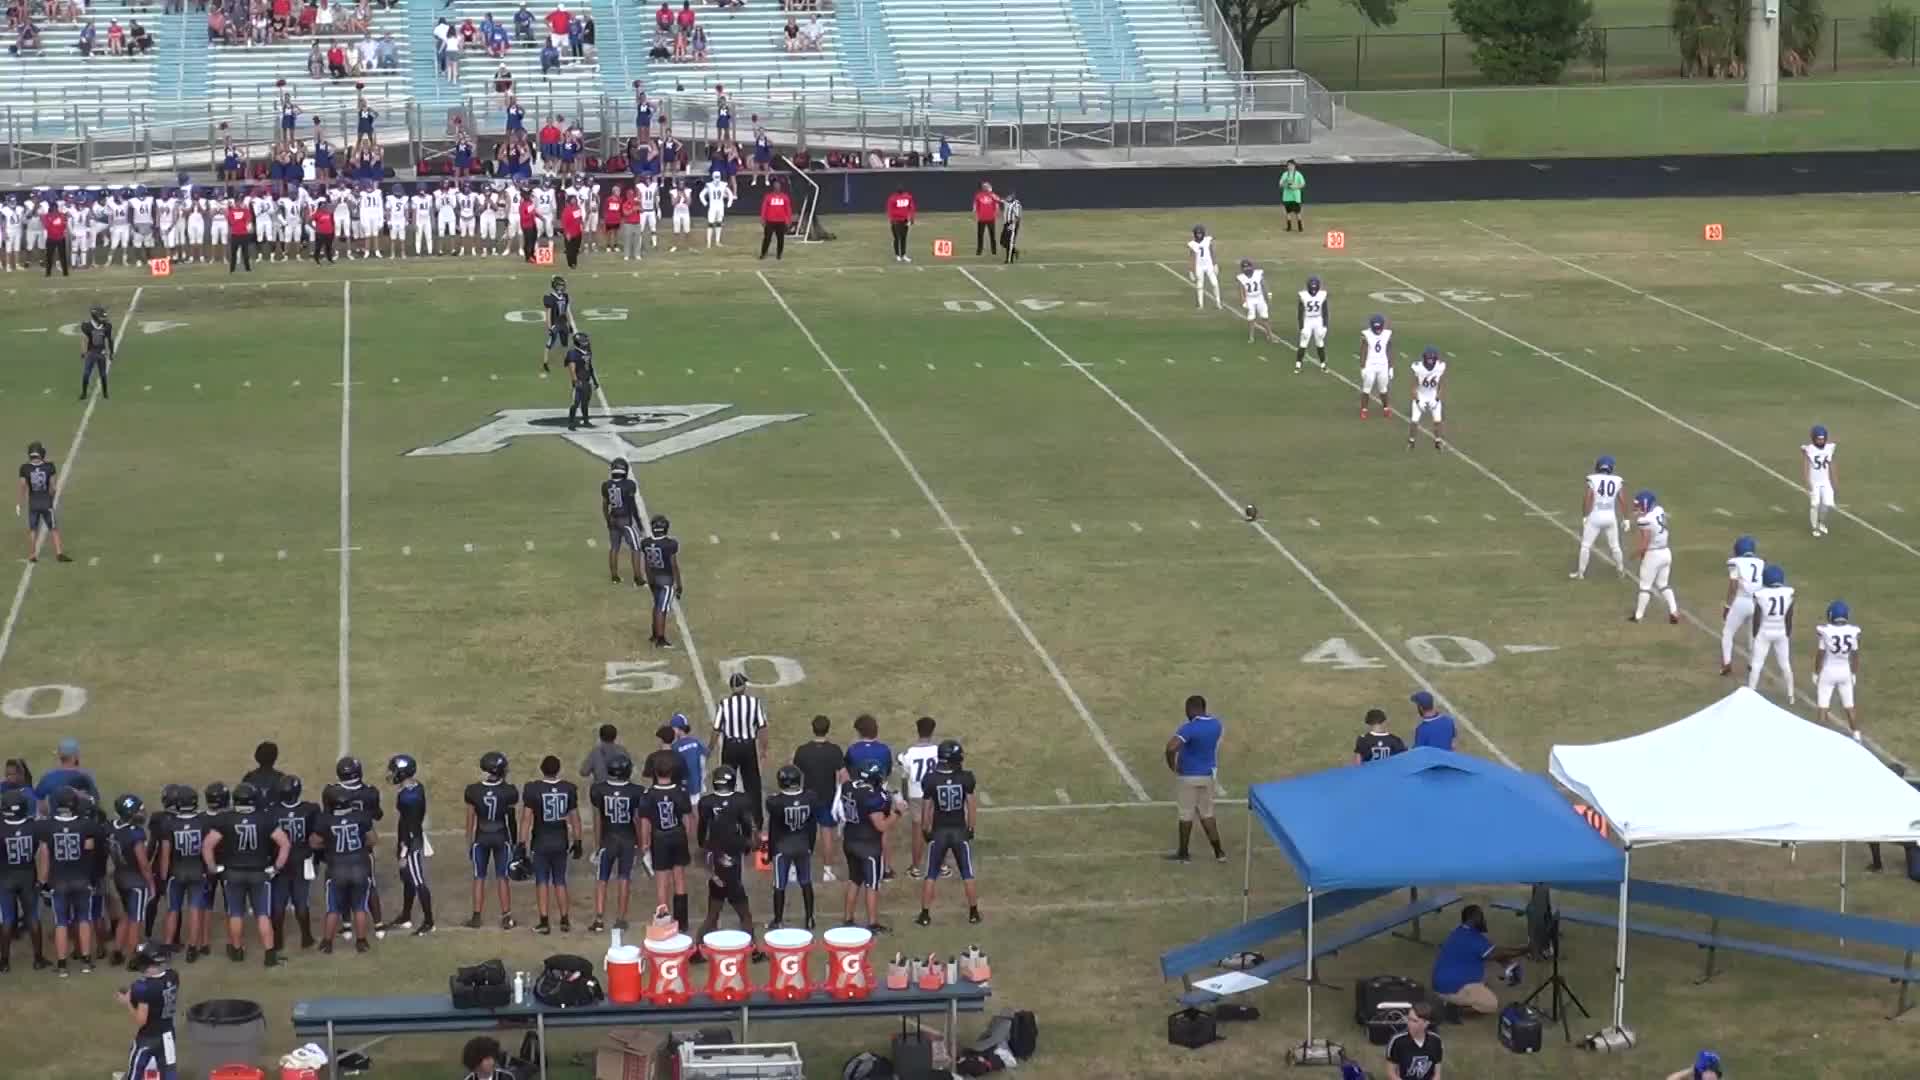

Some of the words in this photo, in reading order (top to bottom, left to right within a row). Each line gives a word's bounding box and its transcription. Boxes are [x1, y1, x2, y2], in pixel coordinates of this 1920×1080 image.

[1329, 233, 1343, 247] 30
[1708, 226, 1721, 239] 20
[153, 259, 168, 273] 40
[538, 249, 552, 263] 50
[1306, 300, 1321, 313] 55
[1374, 340, 1382, 354] 6
[1422, 375, 1437, 389] 66
[1597, 479, 1616, 498] 40
[1750, 563, 1758, 584] 2
[1767, 594, 1785, 616] 21
[1300, 635, 1496, 670] 40
[1830, 634, 1853, 655] 35
[600, 655, 806, 693] 50
[541, 793, 568, 822] 50
[660, 960, 678, 980] G
[720, 956, 737, 976] G
[781, 955, 799, 975] G
[843, 953, 860, 974] G
